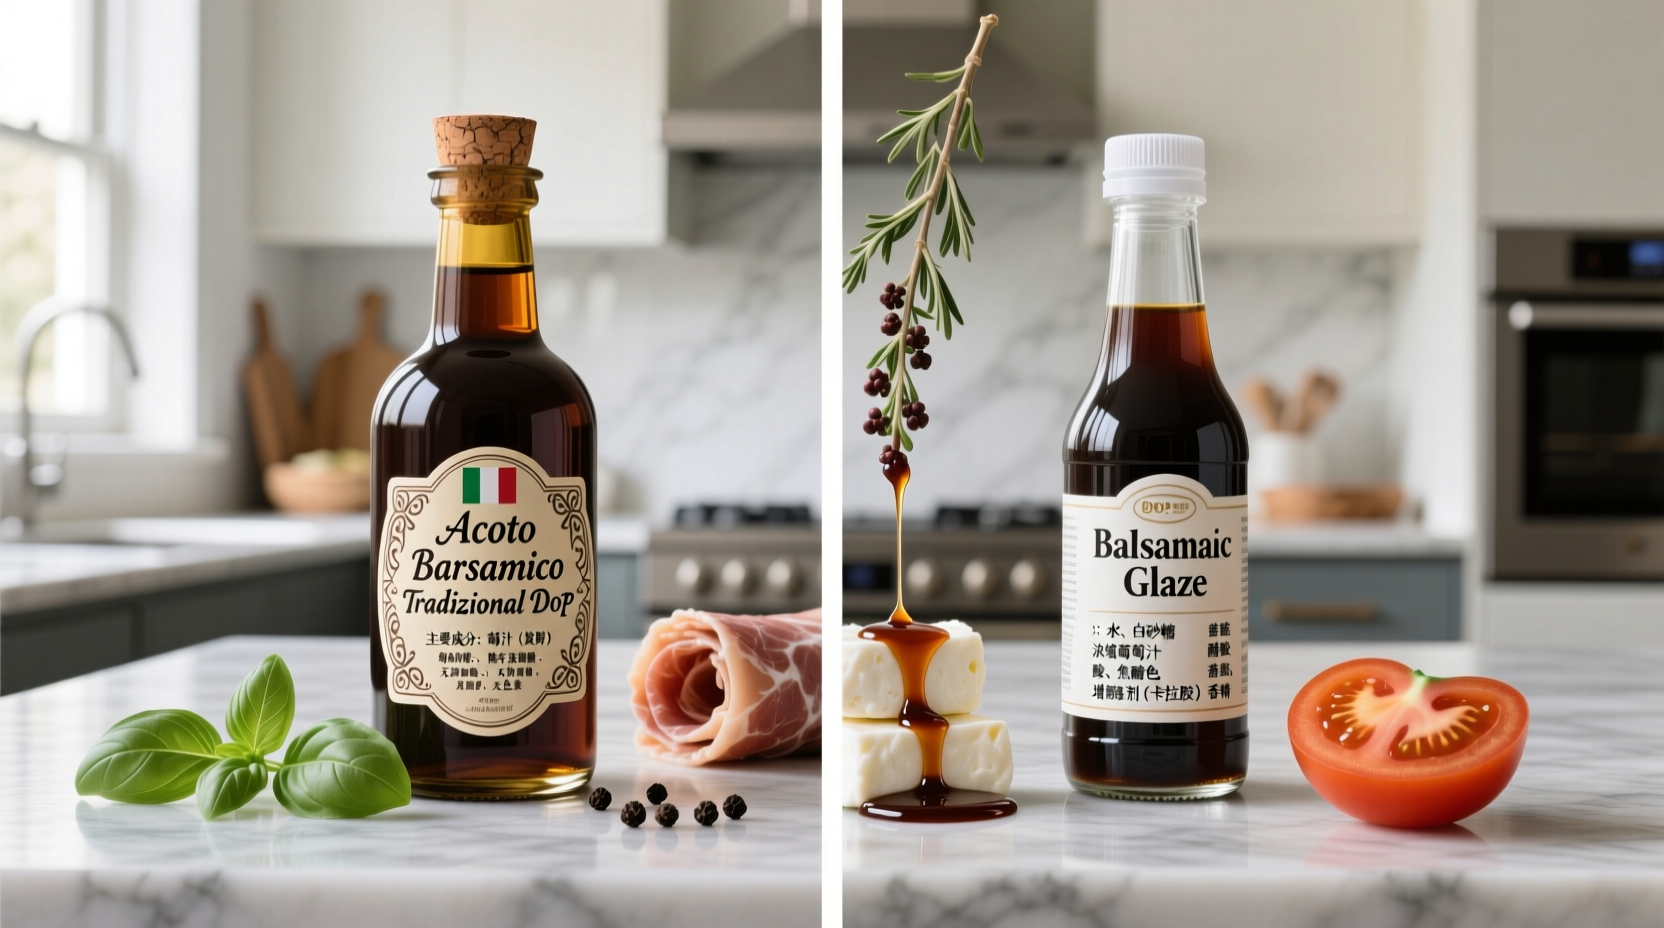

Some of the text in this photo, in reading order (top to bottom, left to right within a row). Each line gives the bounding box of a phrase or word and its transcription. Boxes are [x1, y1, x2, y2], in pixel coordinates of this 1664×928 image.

[436, 511, 536, 545] Acoto
[1095, 528, 1231, 559] Balsamaic
[412, 549, 564, 581] Barsamico
[1124, 566, 1207, 597] Glaze
[403, 589, 526, 614] Tradizional
